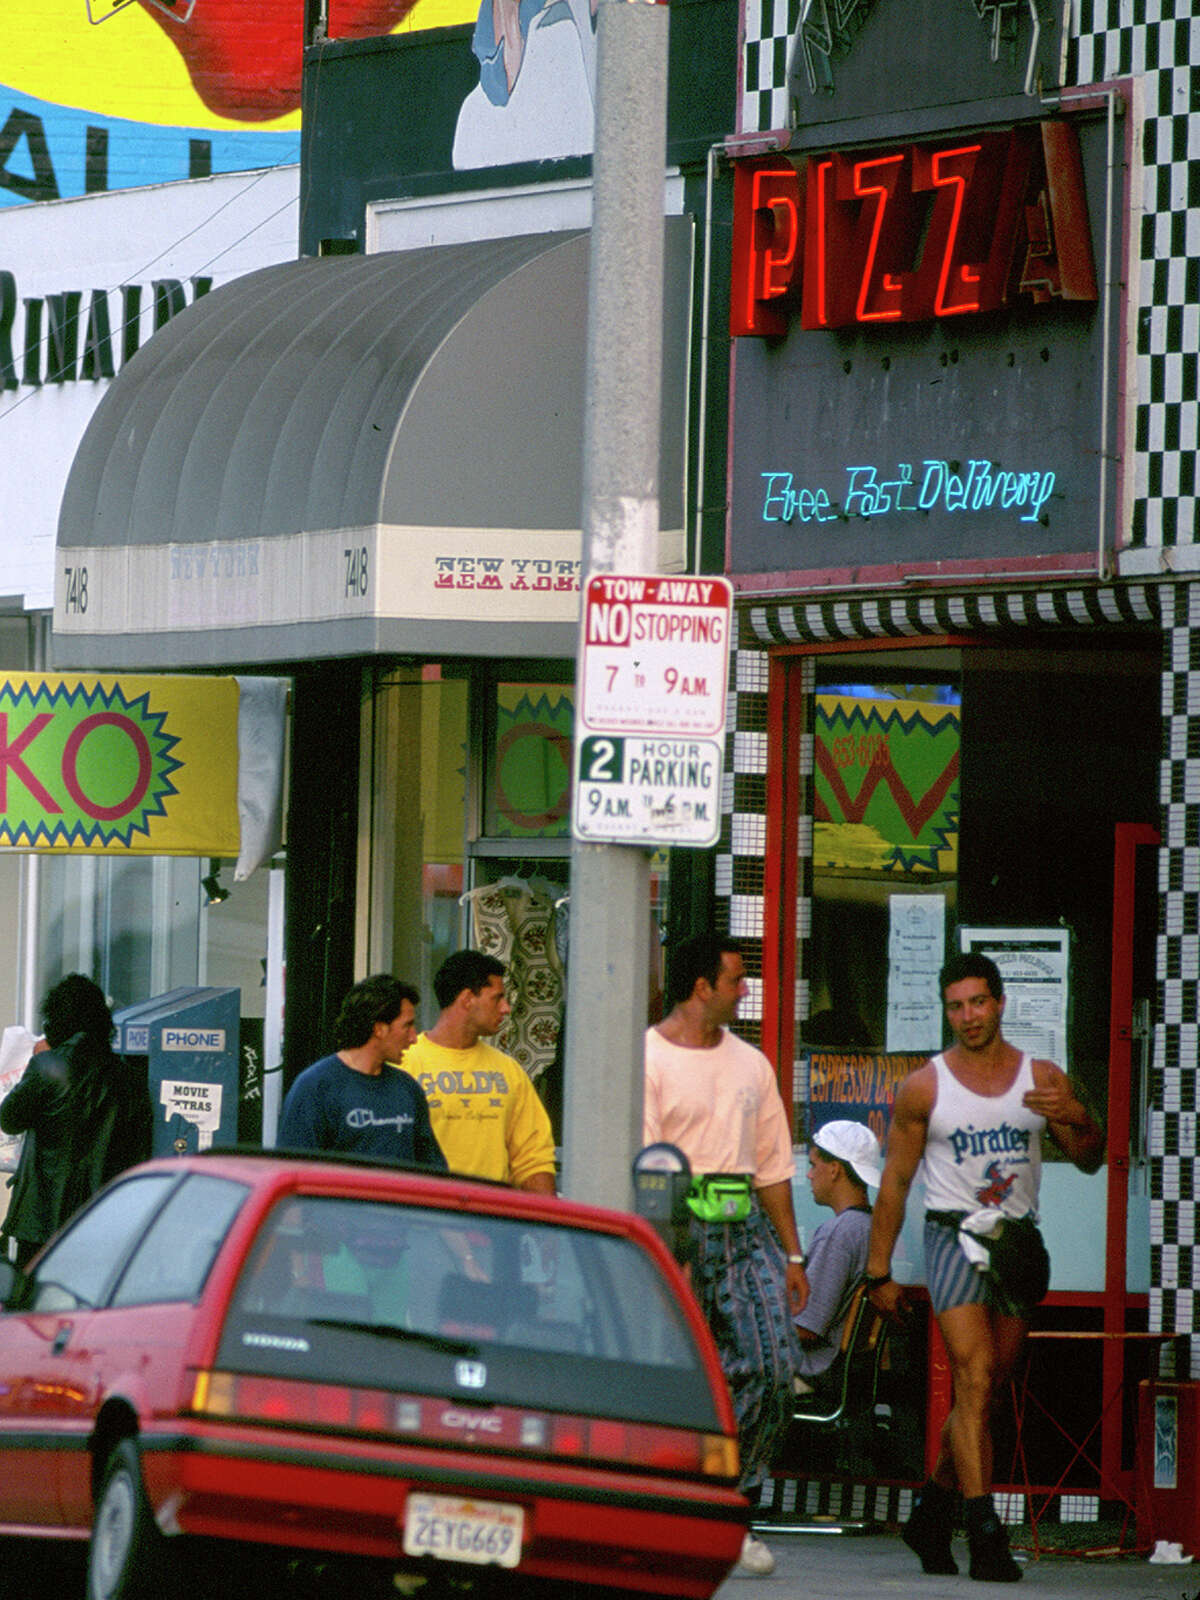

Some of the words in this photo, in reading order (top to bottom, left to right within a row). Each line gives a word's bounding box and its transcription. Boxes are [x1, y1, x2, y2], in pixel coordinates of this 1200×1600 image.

[730, 122, 1098, 337] PIZZA
[761, 472, 838, 522] Free
[844, 463, 917, 517] Fast
[918, 460, 1057, 522] Delivery
[344, 546, 369, 598] 7418
[64, 567, 89, 614] 7418
[589, 604, 630, 645] NO
[634, 613, 723, 645] STOPPING
[606, 666, 619, 693] 7
[589, 740, 616, 780] 2
[643, 743, 700, 759] HOUR
[630, 758, 712, 789] PARKING
[166, 1031, 221, 1047] PHONE
[173, 1085, 209, 1099] MOVIE
[418, 1071, 509, 1095] GOLD'S
[169, 1099, 213, 1113] TRAS
[440, 1409, 504, 1433] CIVIC
